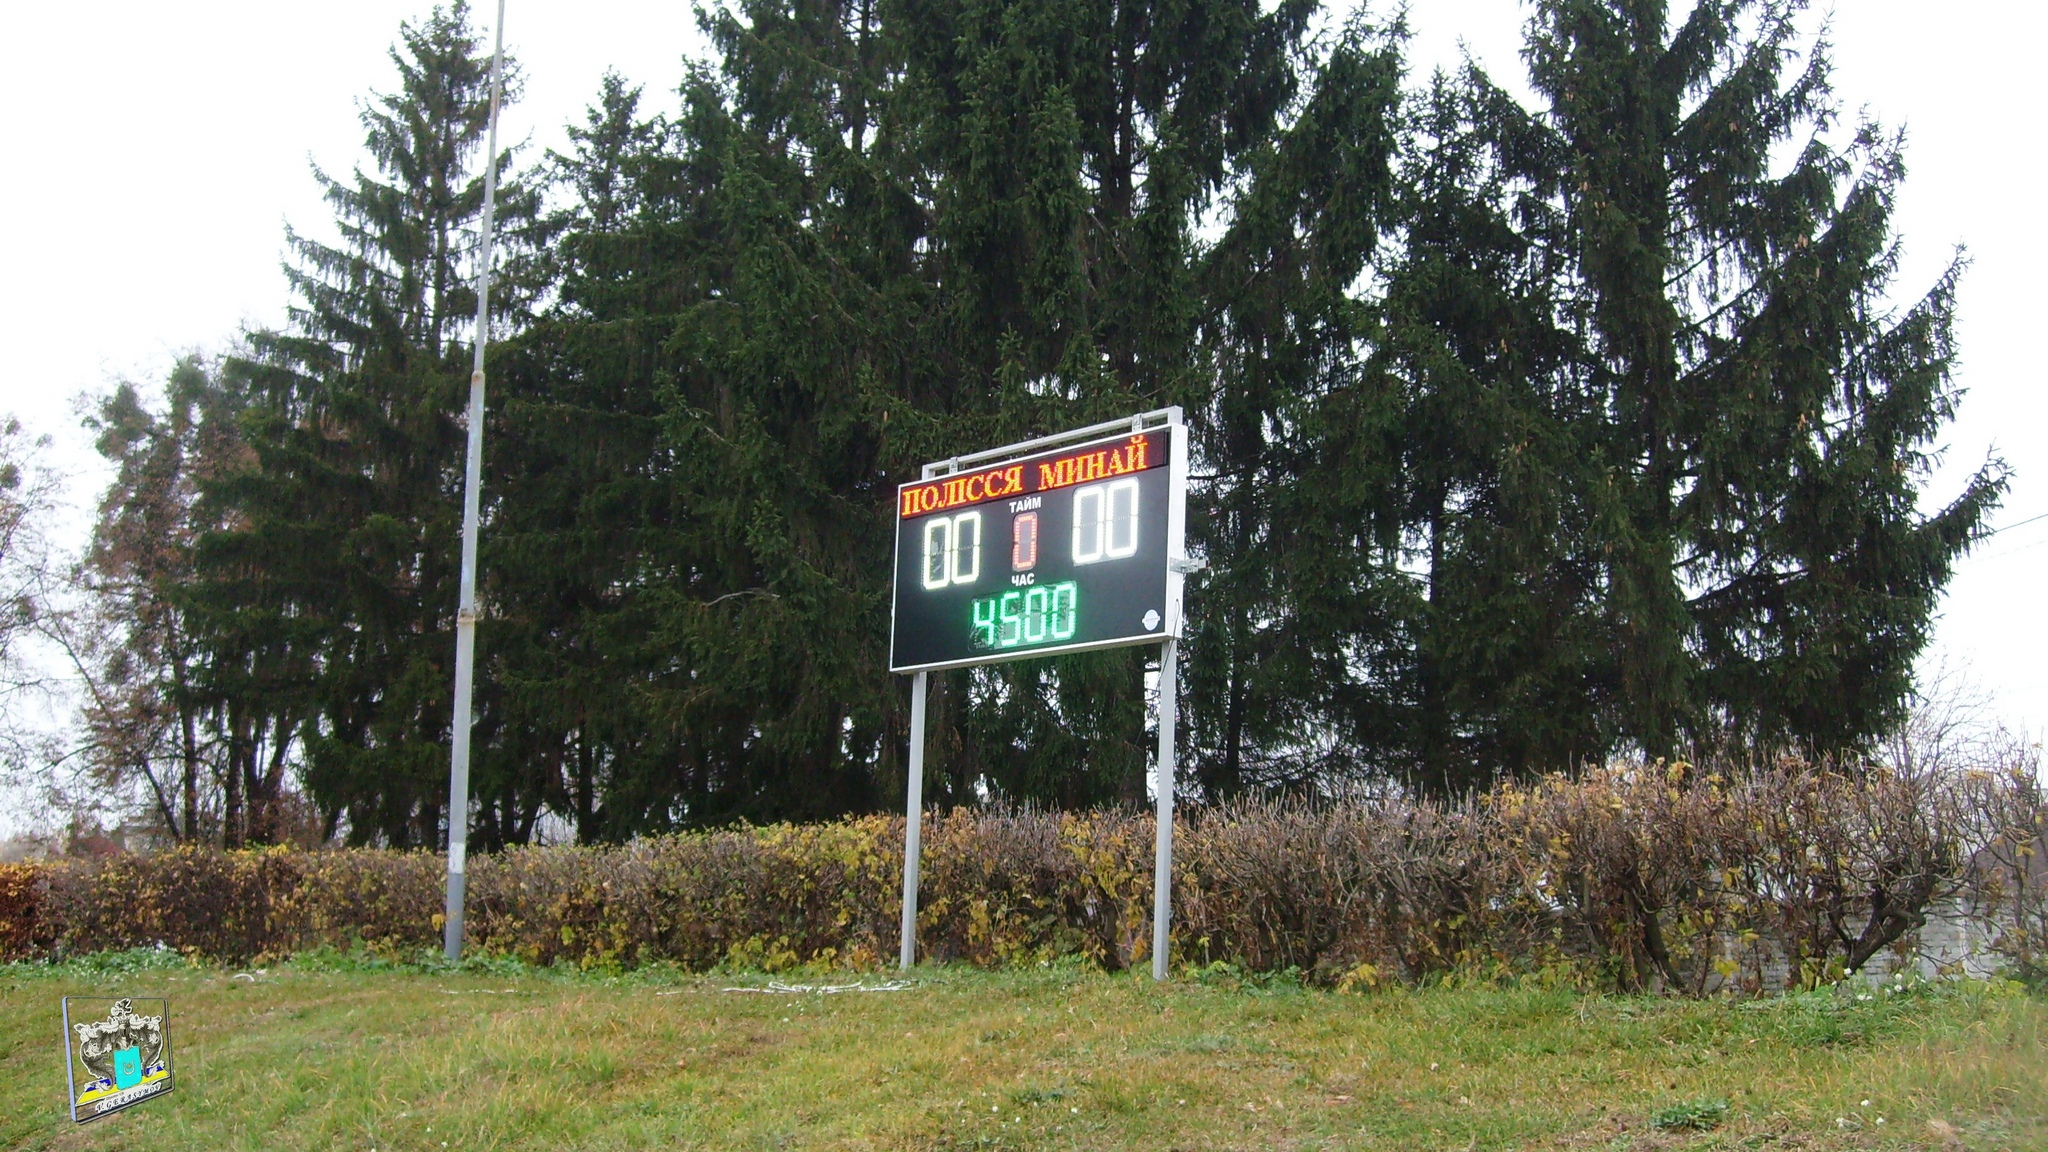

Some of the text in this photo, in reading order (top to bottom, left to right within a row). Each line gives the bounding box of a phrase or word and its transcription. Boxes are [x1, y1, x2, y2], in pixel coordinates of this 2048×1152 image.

[902, 434, 1148, 516] ПОЛІССЯ МИНАЙ
[1009, 496, 1042, 513] ТАЙМ
[922, 511, 982, 590] 00
[1013, 513, 1037, 570] 0
[1072, 478, 1139, 565] 00
[1011, 573, 1035, 587] ЧАС
[973, 582, 1076, 647] 4500
